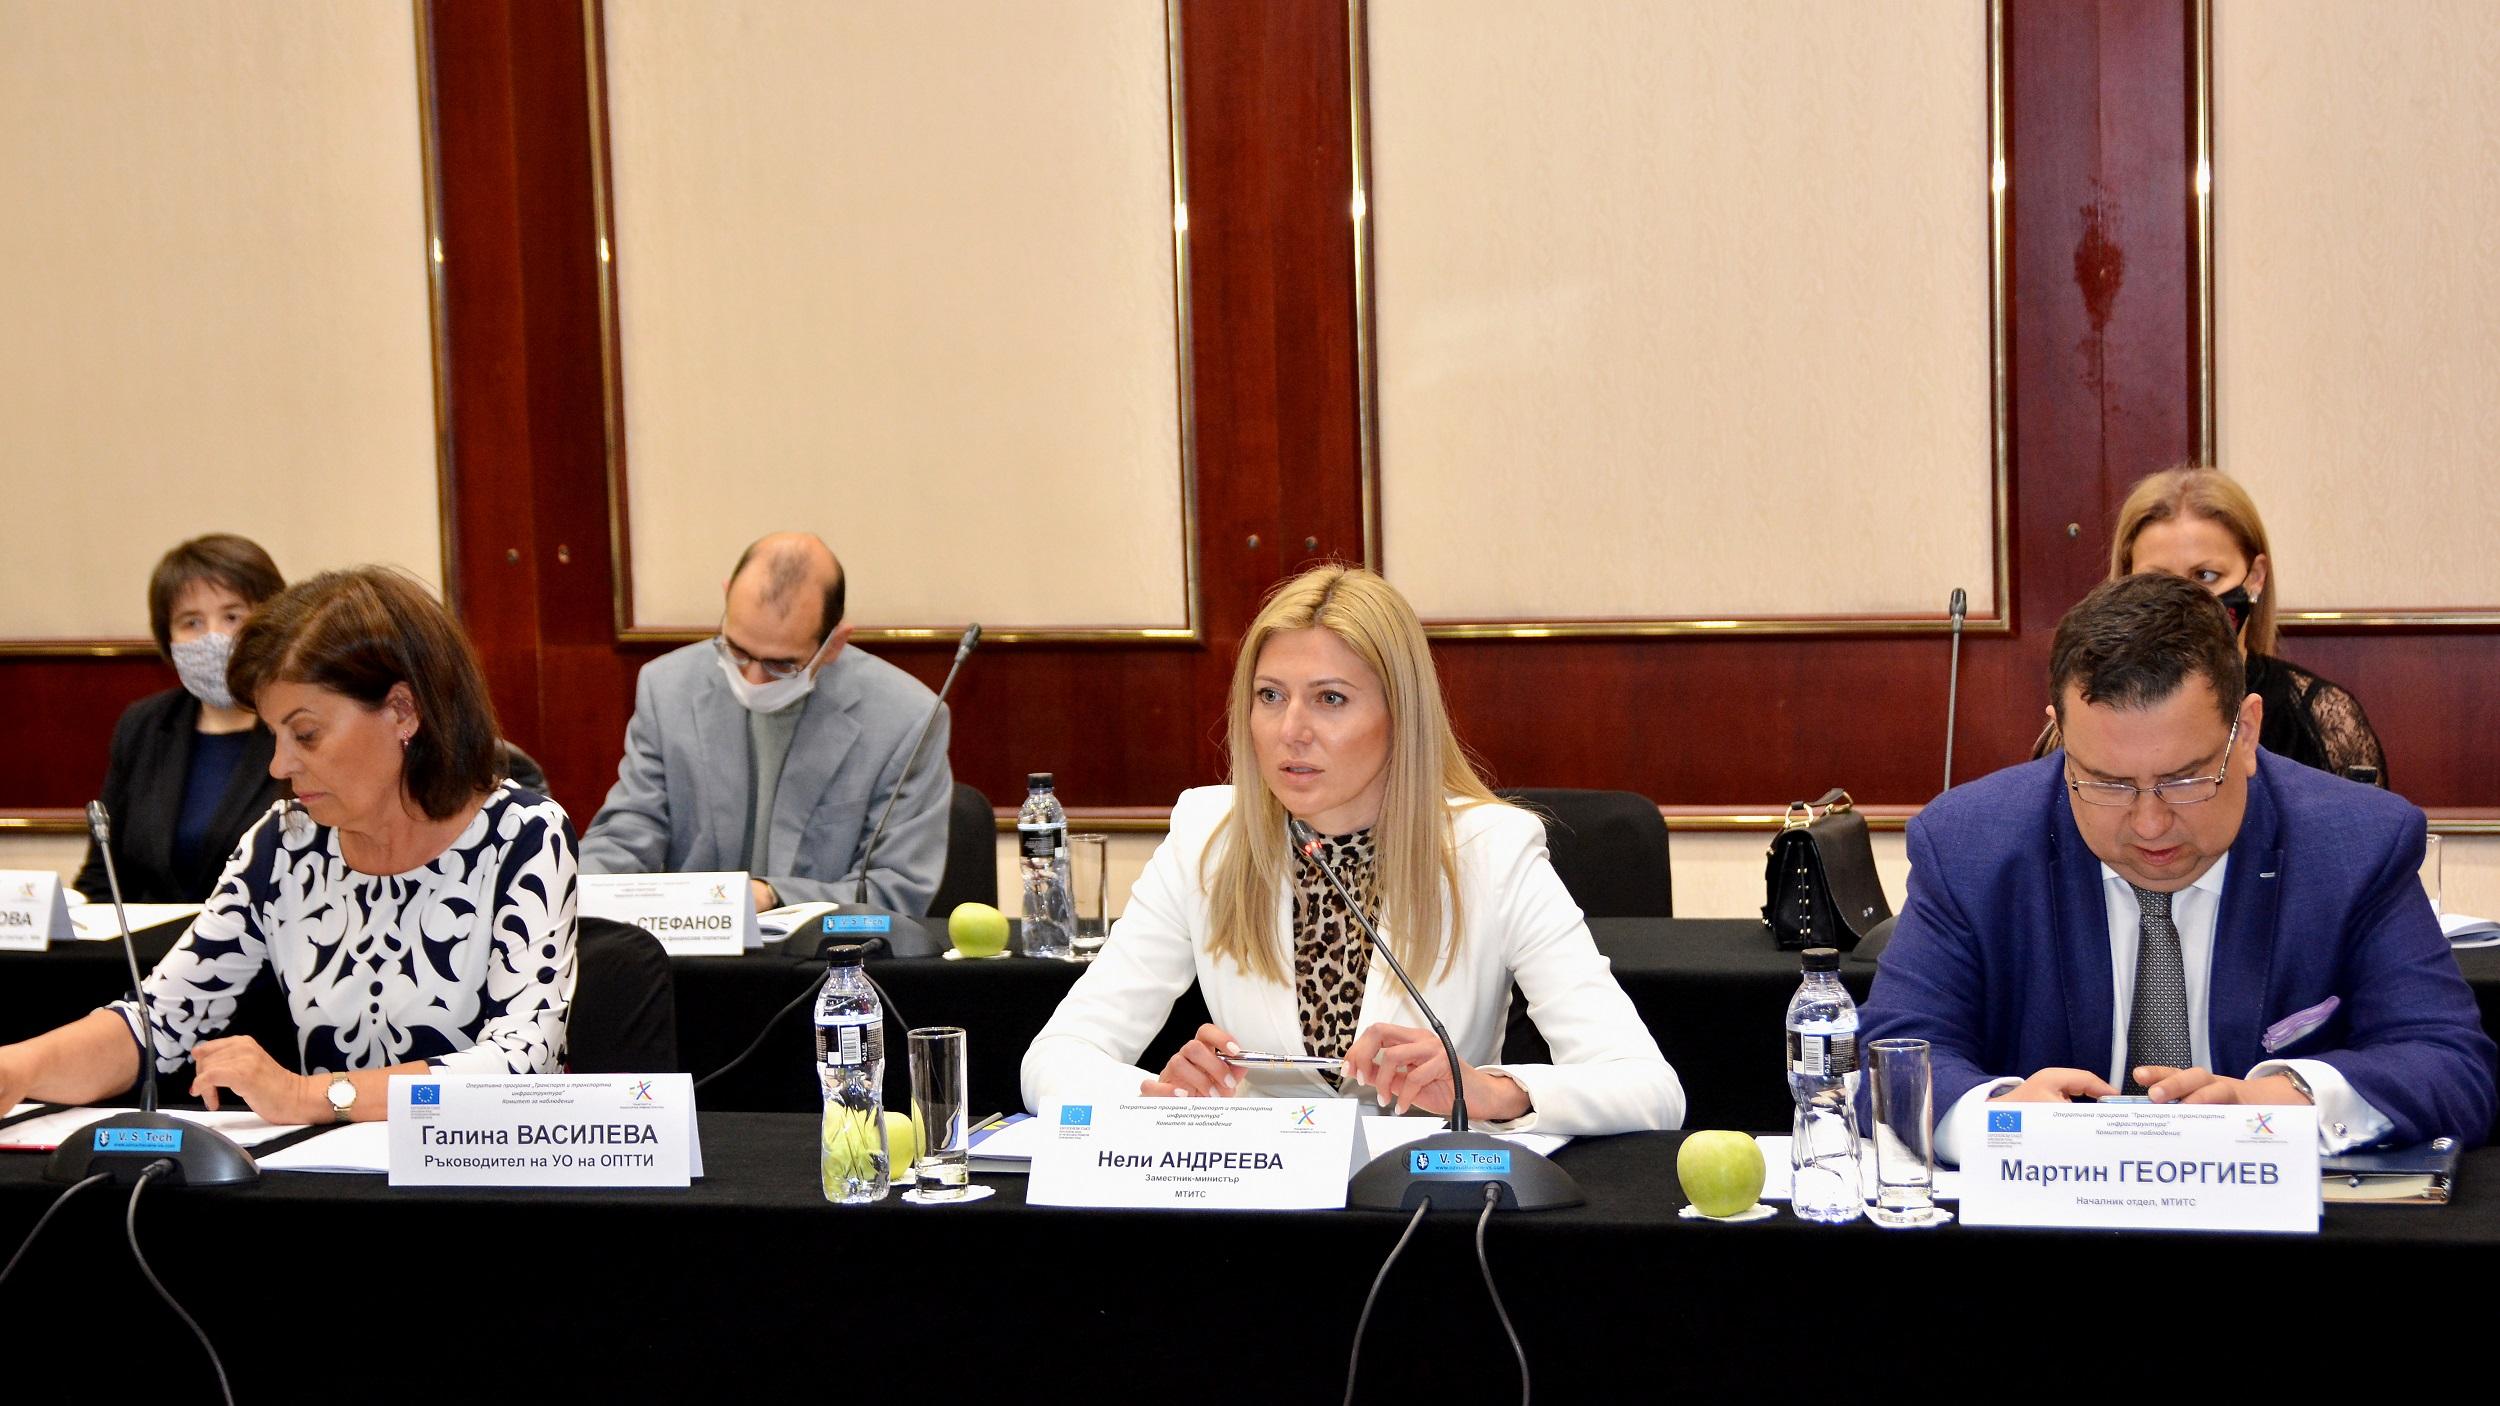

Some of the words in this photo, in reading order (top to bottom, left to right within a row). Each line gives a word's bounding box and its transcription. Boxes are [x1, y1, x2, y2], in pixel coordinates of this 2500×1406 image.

[637, 915, 732, 930] СТЕФАНОВ
[146, 1132, 172, 1142] Tech
[422, 1125, 509, 1145] Галина
[517, 1124, 659, 1145] ВАСИЛЕВА
[425, 1155, 525, 1169] Ръководител
[530, 1157, 547, 1167] на
[552, 1154, 573, 1167] УО
[578, 1157, 595, 1167] на
[600, 1154, 654, 1167] ОПТТИ
[1098, 1150, 1153, 1168] Нели
[1159, 1151, 1284, 1171] АНДРЕЕВА
[1439, 1153, 1450, 1164] V.
[1455, 1153, 1466, 1164] S.
[1471, 1153, 1501, 1164] Tech
[1145, 1173, 1240, 1183] Заместник-министър
[2000, 1158, 2108, 1187] Мартин
[2119, 1160, 2279, 1185] ГЕОРГИЕВ
[1174, 1190, 1206, 1198] МТИТС
[2076, 1196, 2124, 1206] Началник
[2126, 1198, 2158, 1207] отдел,
[2161, 1198, 2196, 1207] МТИТС
